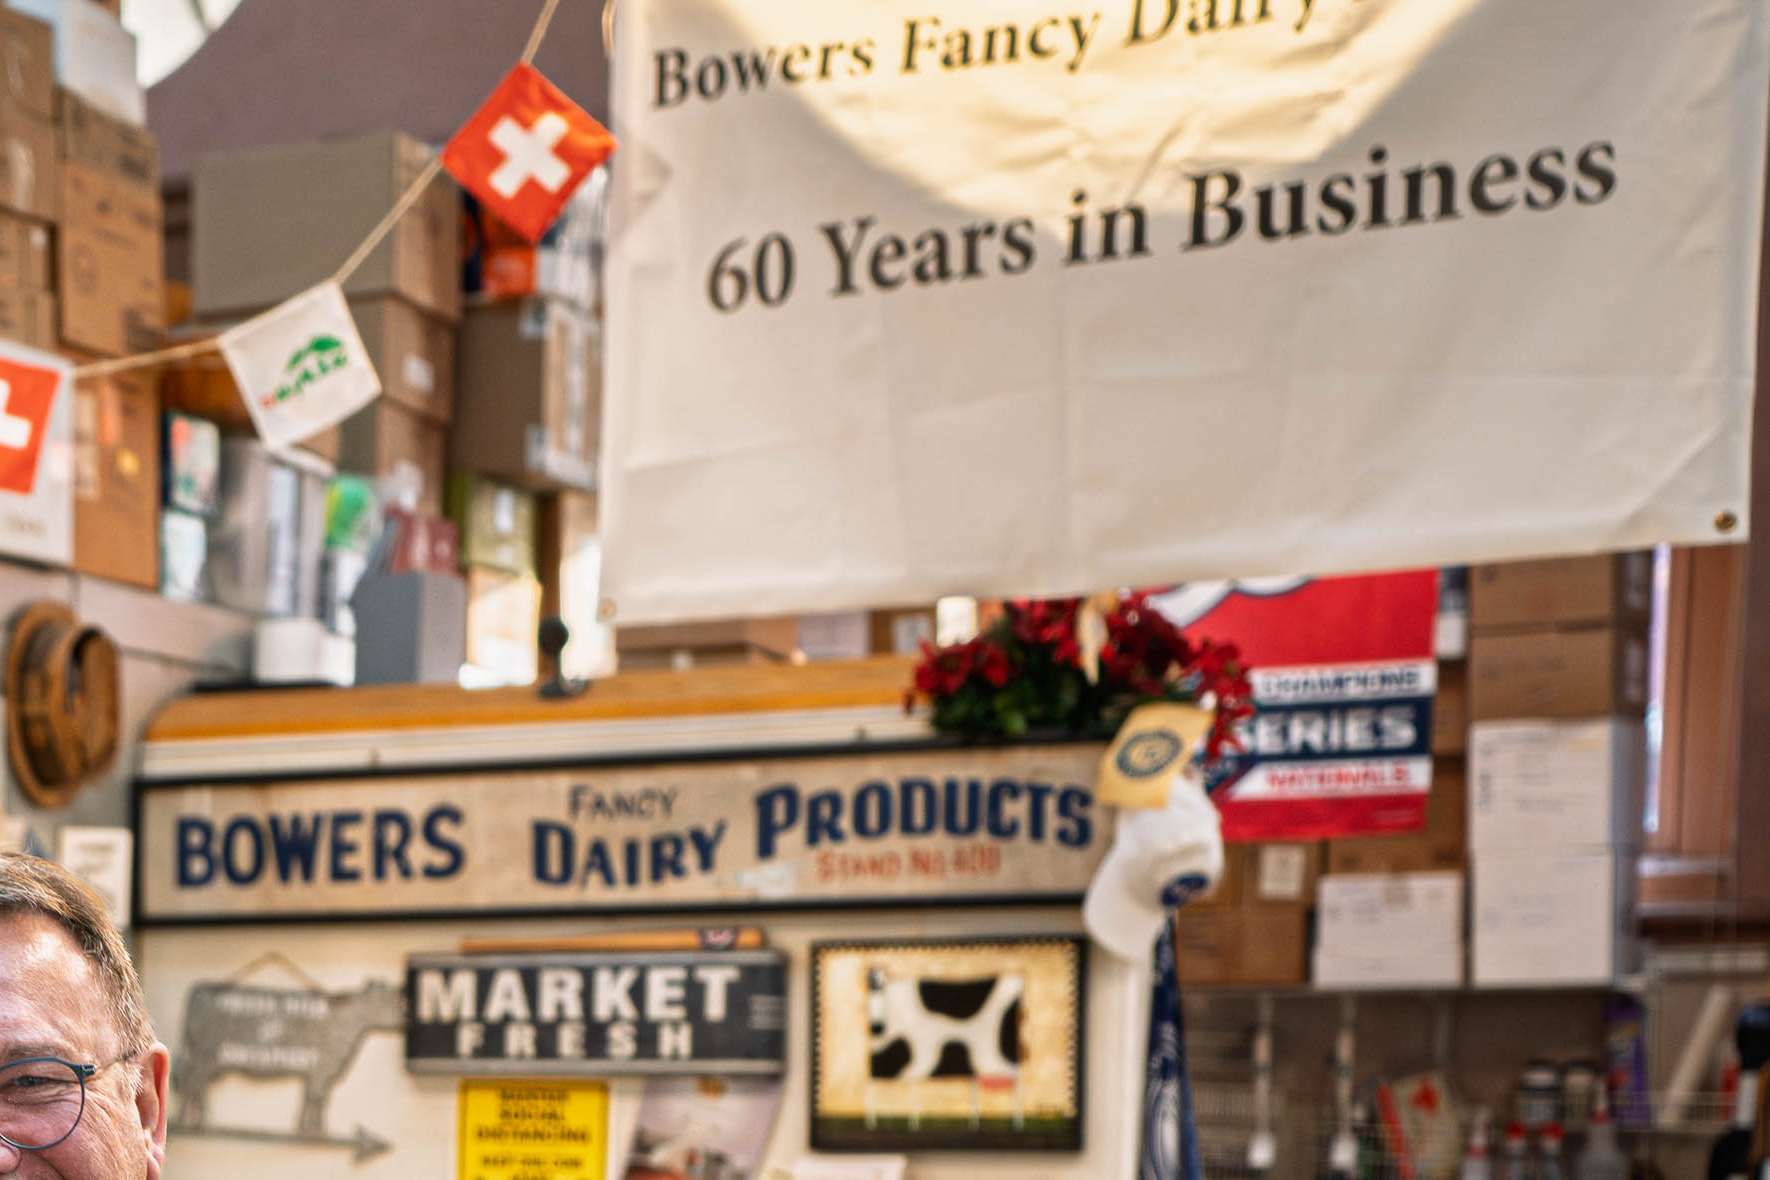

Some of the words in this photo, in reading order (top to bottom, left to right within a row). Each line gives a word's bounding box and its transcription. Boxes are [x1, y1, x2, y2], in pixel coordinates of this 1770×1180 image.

[653, 37, 876, 111] Bowers
[901, 12, 1101, 74] Fancy
[708, 232, 796, 313] 60
[819, 215, 1036, 299] Years
[1064, 189, 1153, 267] in
[1181, 140, 1619, 253] Business
[568, 784, 678, 821] FANCY
[755, 778, 1094, 861] PRODUCTS
[175, 803, 466, 889] BOWERS
[531, 819, 728, 889] DAIRY
[815, 848, 901, 883] STAND
[417, 966, 741, 1023] MARKET
[457, 1022, 693, 1058] FRESH
